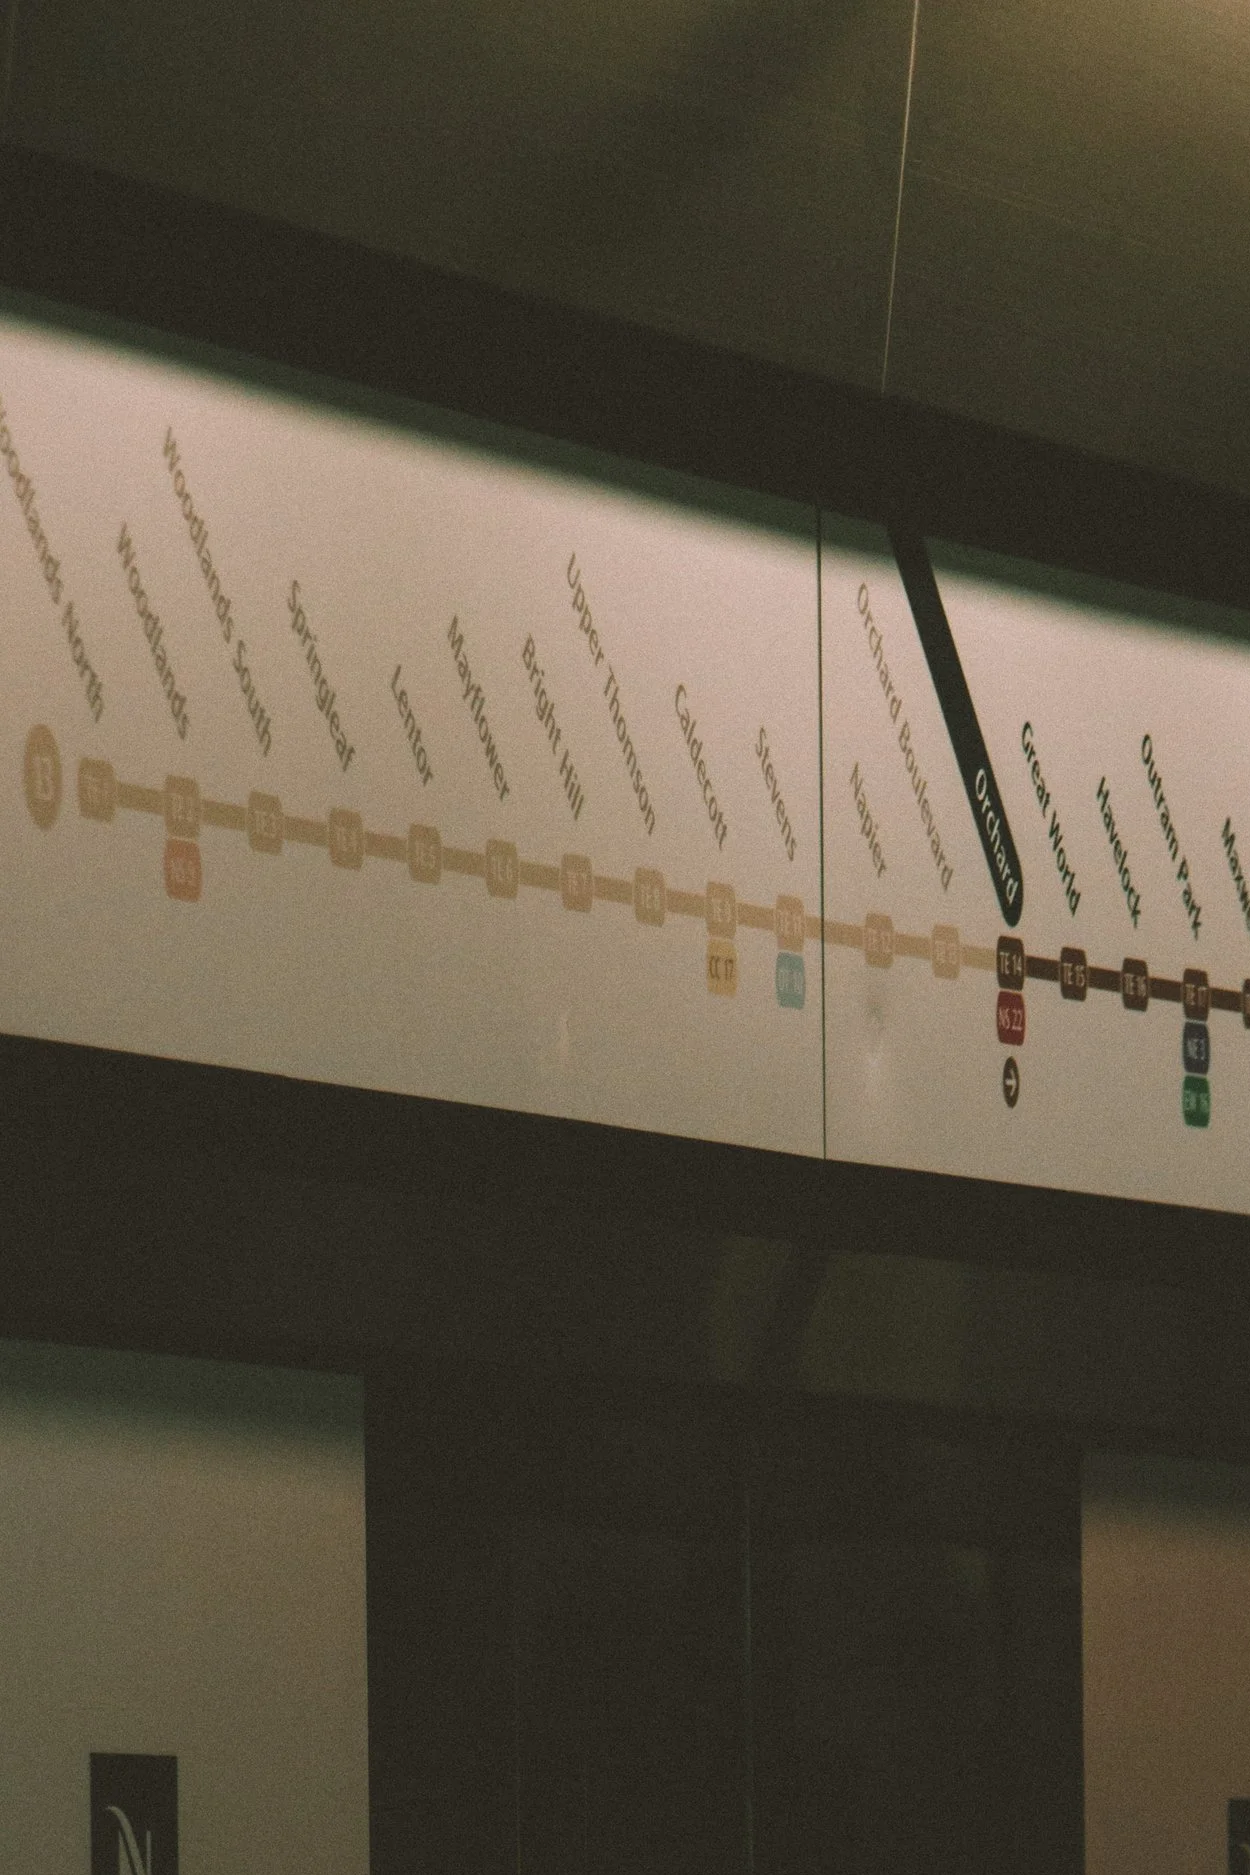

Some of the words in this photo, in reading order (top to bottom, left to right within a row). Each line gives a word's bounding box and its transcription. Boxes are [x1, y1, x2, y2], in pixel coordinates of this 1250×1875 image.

[0, 396, 62, 604] oodlands
[62, 600, 104, 723] North
[116, 520, 188, 740] Woodlands
[163, 425, 234, 644] Woodlands
[233, 639, 272, 758] South
[287, 579, 356, 773] Springleaf
[390, 664, 434, 787] Lentor
[447, 614, 511, 801] Mayflower
[521, 632, 562, 755] Bright
[559, 750, 586, 822] Hill
[566, 551, 604, 667] Upper
[603, 664, 656, 836] Thomson
[674, 683, 728, 851] Caldecott
[856, 582, 903, 725] Orchard
[898, 721, 954, 893] Boulevard
[755, 726, 797, 862] Stevens
[849, 761, 888, 879] Napier
[974, 767, 1019, 903] Orchard
[1020, 720, 1052, 819] Great
[1048, 809, 1082, 918] World
[1095, 775, 1142, 931] Havelock
[1140, 732, 1180, 863] Outram
[1175, 855, 1203, 941] Park
[998, 950, 1011, 974] TE
[1012, 952, 1023, 977] 14
[998, 1007, 1011, 1029] NS
[1011, 1008, 1023, 1032] 22
